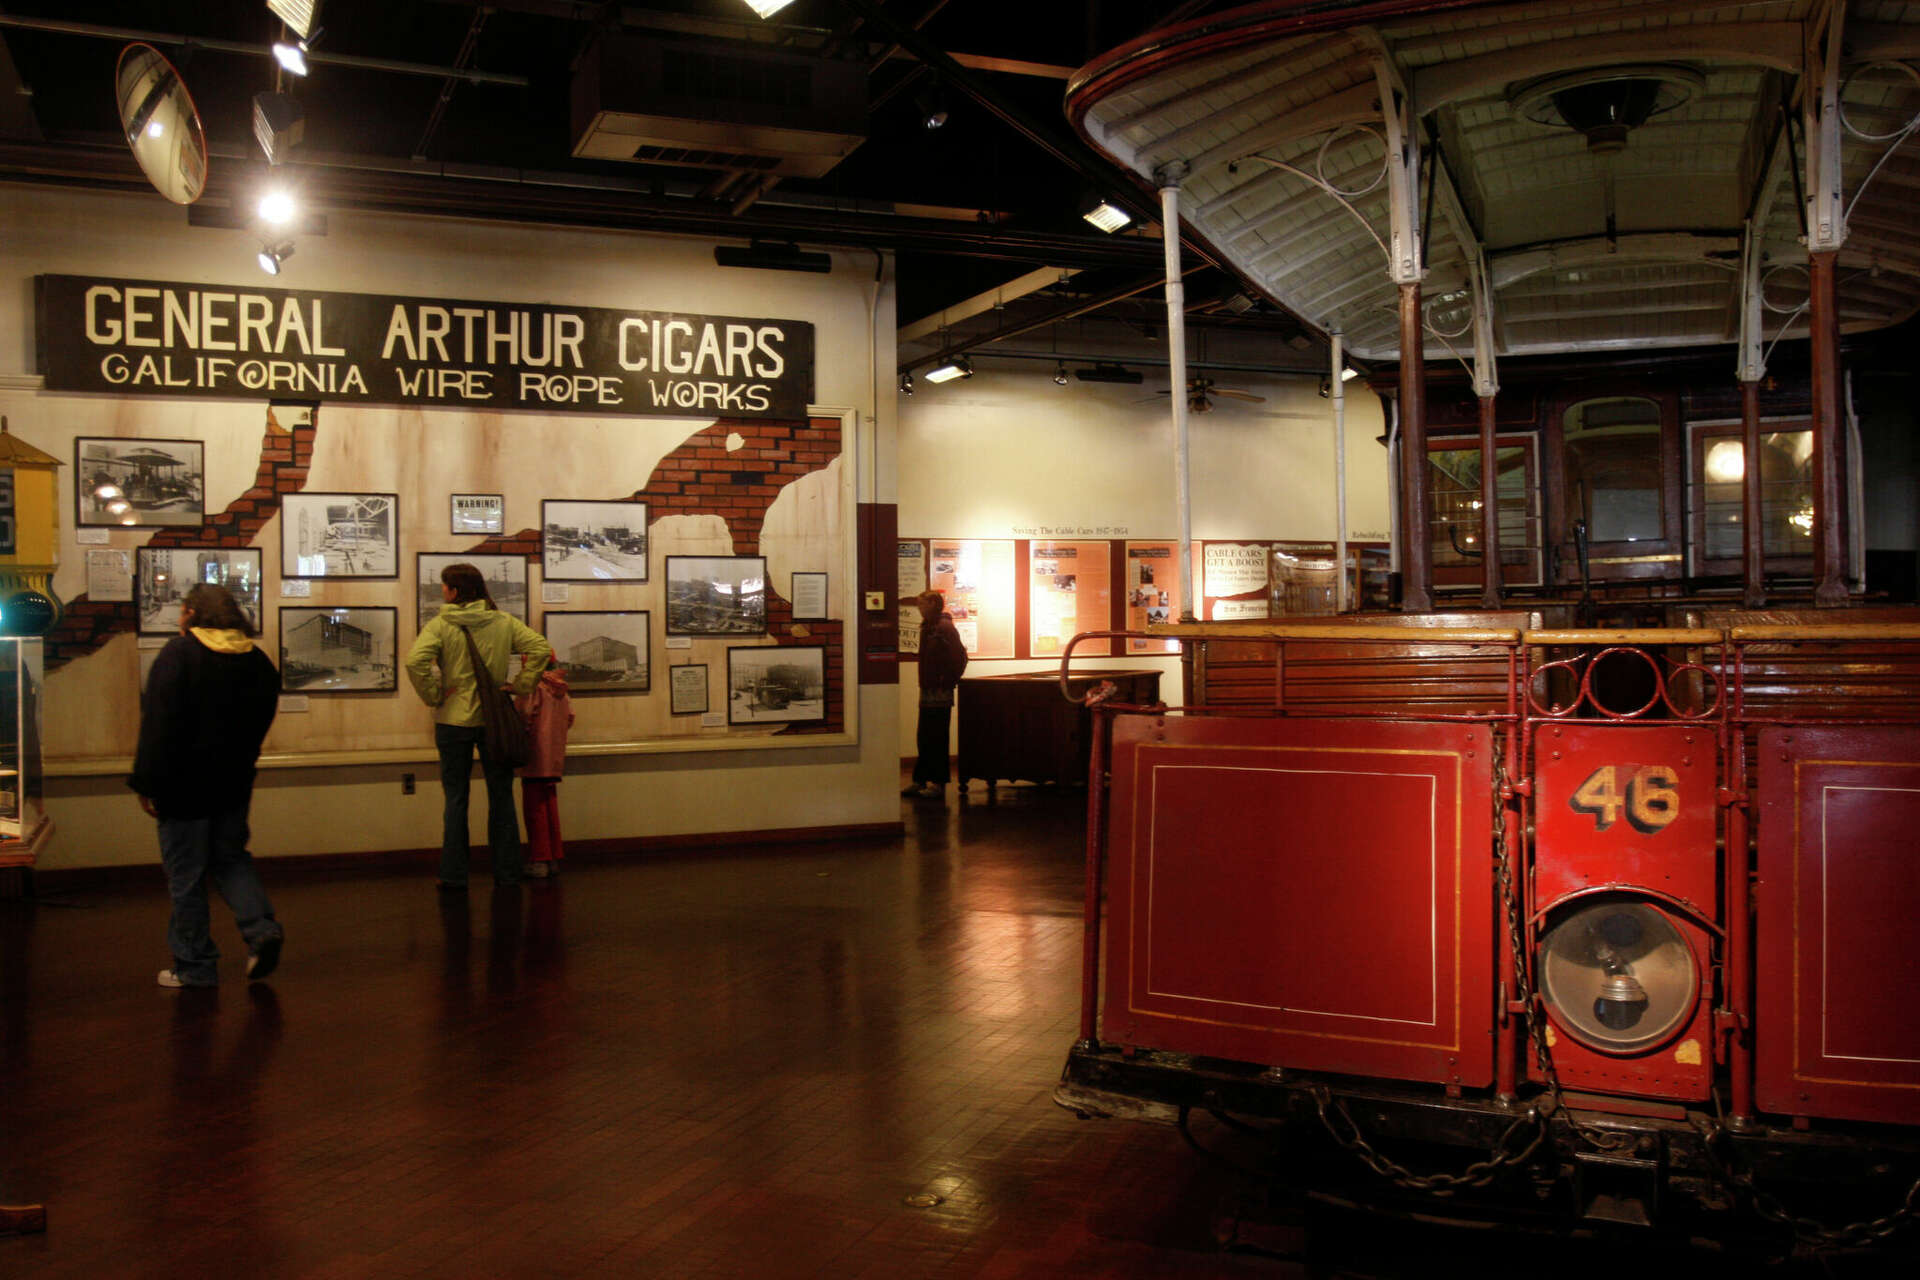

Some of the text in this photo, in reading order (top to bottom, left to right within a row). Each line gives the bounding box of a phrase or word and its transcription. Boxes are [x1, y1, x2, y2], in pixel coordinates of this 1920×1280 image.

[85, 285, 786, 379] GENERAL ARTHUR CIGARS
[101, 353, 772, 411] CALIFORNIA WIRE ROPE WORKS
[456, 499, 499, 509] WARNING!
[1207, 549, 1261, 558] CABLE CARS
[1236, 559, 1265, 567] BOOST
[1570, 765, 1680, 834] 46
